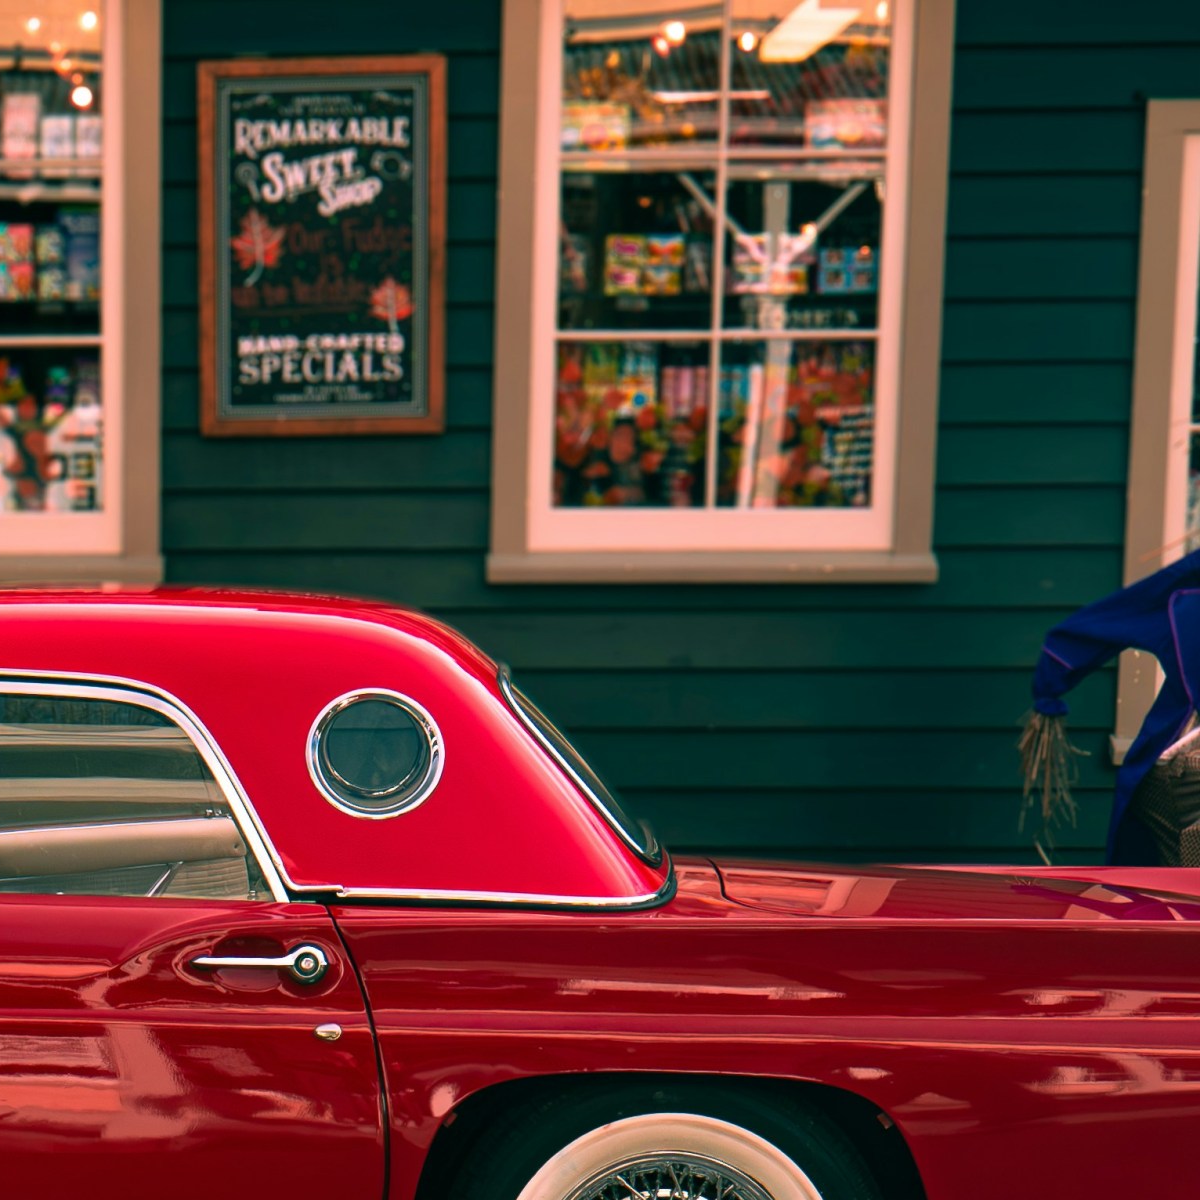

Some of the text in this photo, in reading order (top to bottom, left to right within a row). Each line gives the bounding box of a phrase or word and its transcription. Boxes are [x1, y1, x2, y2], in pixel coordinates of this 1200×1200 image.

[234, 116, 410, 159] REMARKABLE
[261, 147, 357, 204] SWEET
[237, 333, 405, 358] HAND-CRAFTED
[238, 353, 403, 384] SPECIALS
